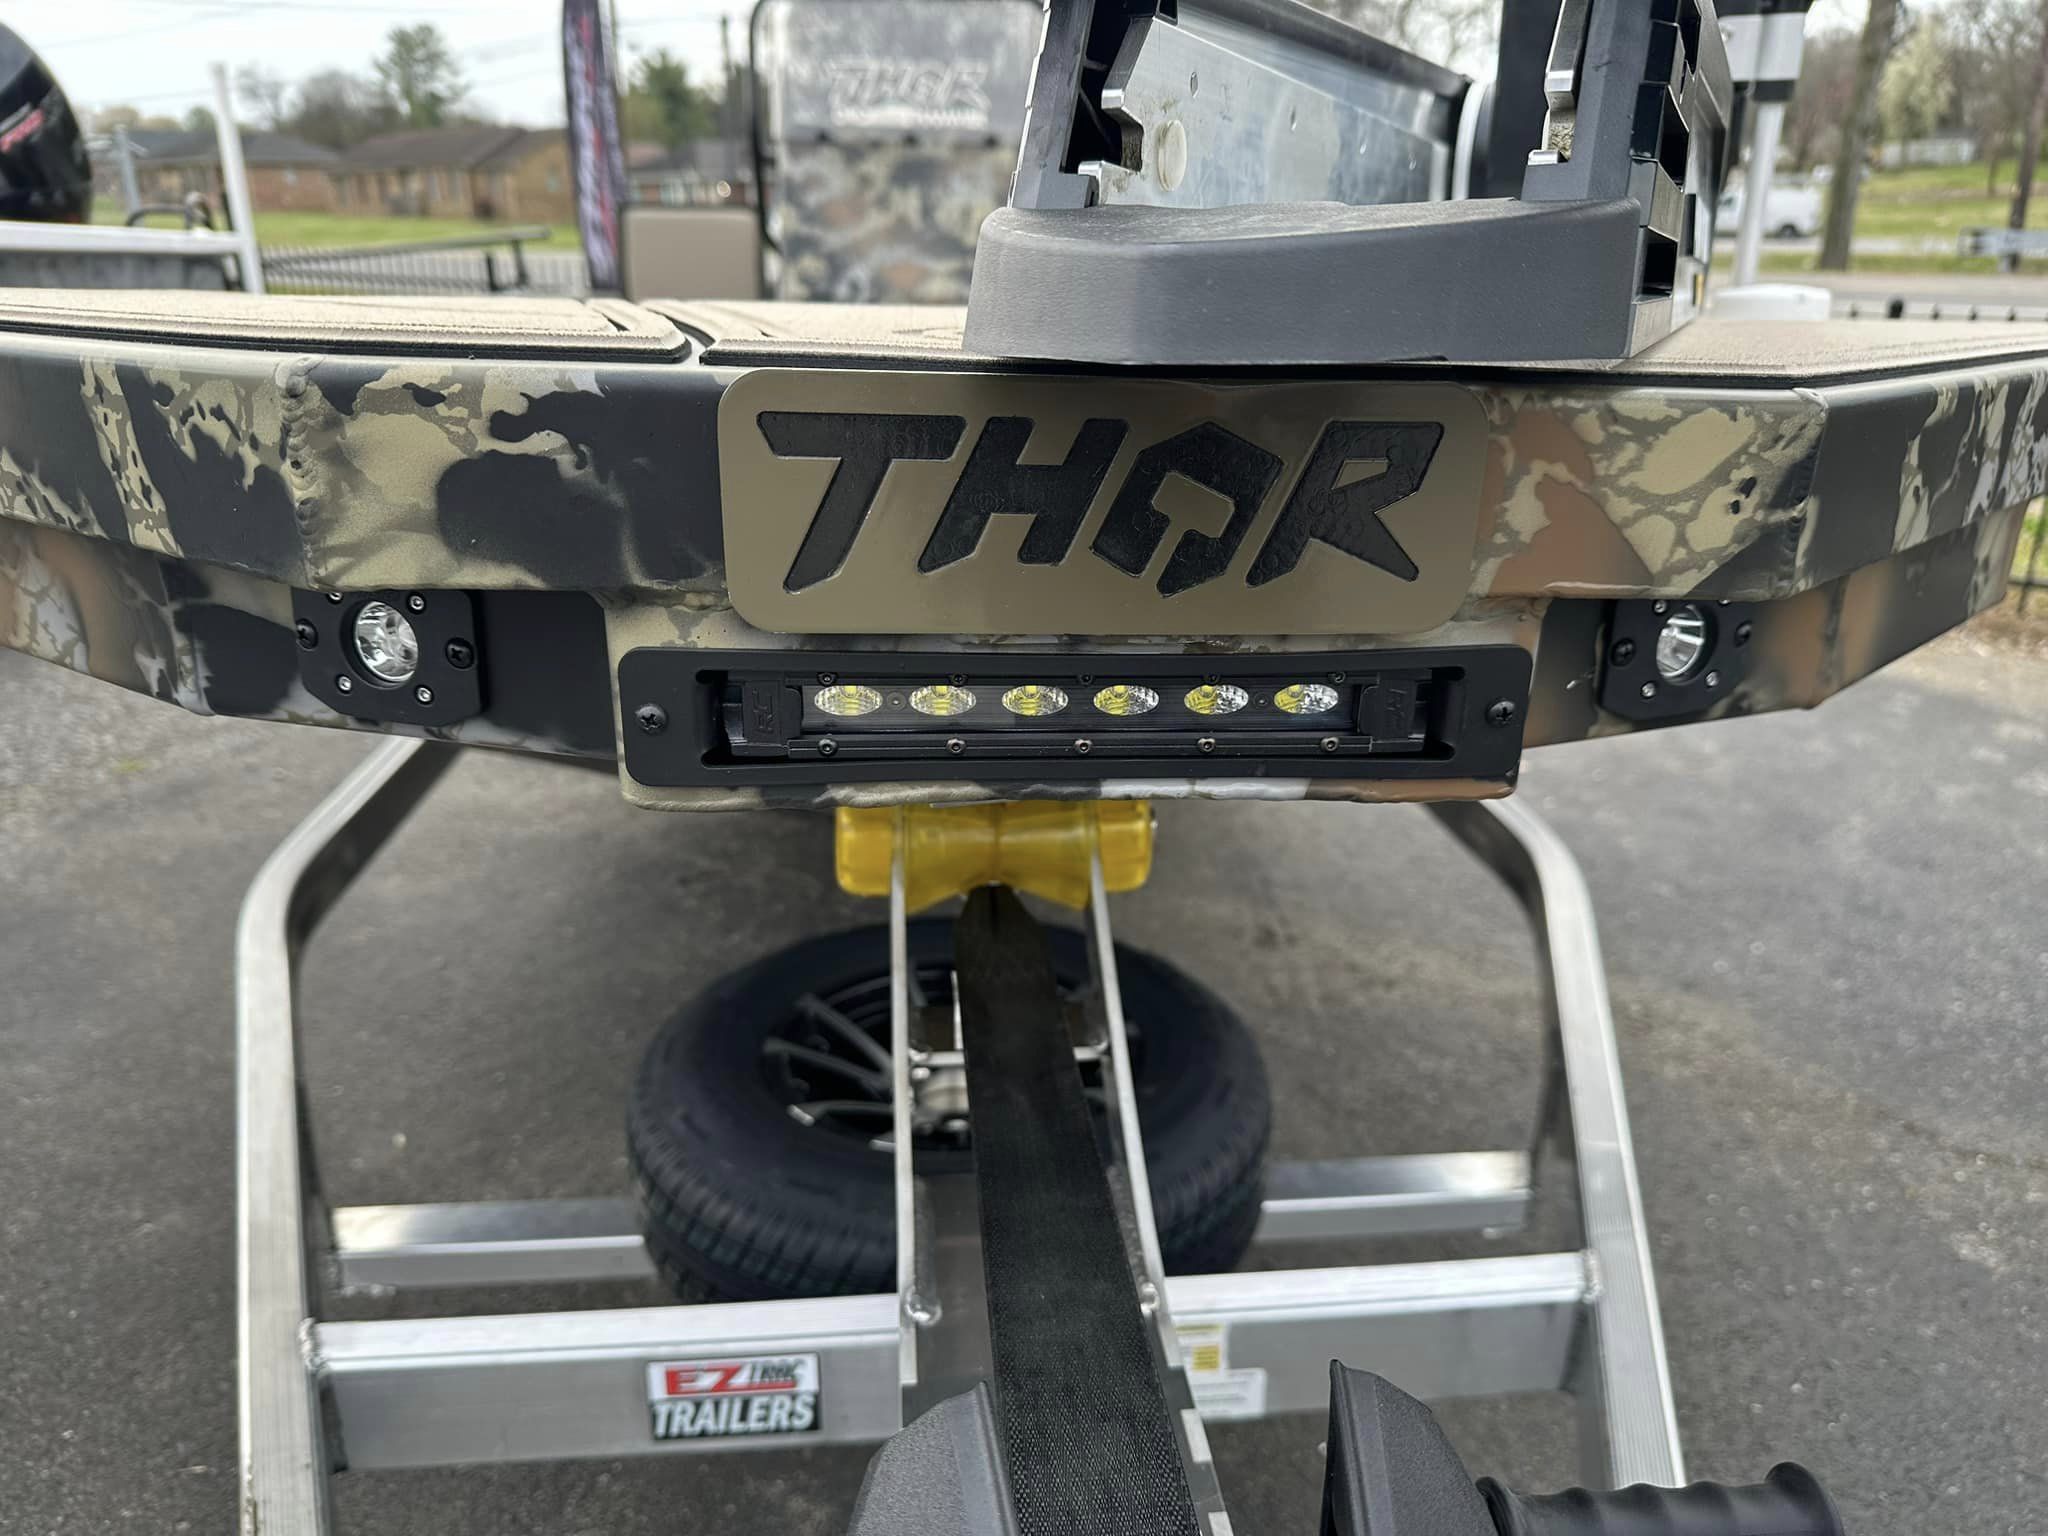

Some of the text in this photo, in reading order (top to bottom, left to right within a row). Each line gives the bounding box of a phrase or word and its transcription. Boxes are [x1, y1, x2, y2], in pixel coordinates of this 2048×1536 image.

[756, 410, 1445, 598] THOR
[665, 1363, 743, 1396] EZ
[653, 1393, 815, 1438] TRAILERS
